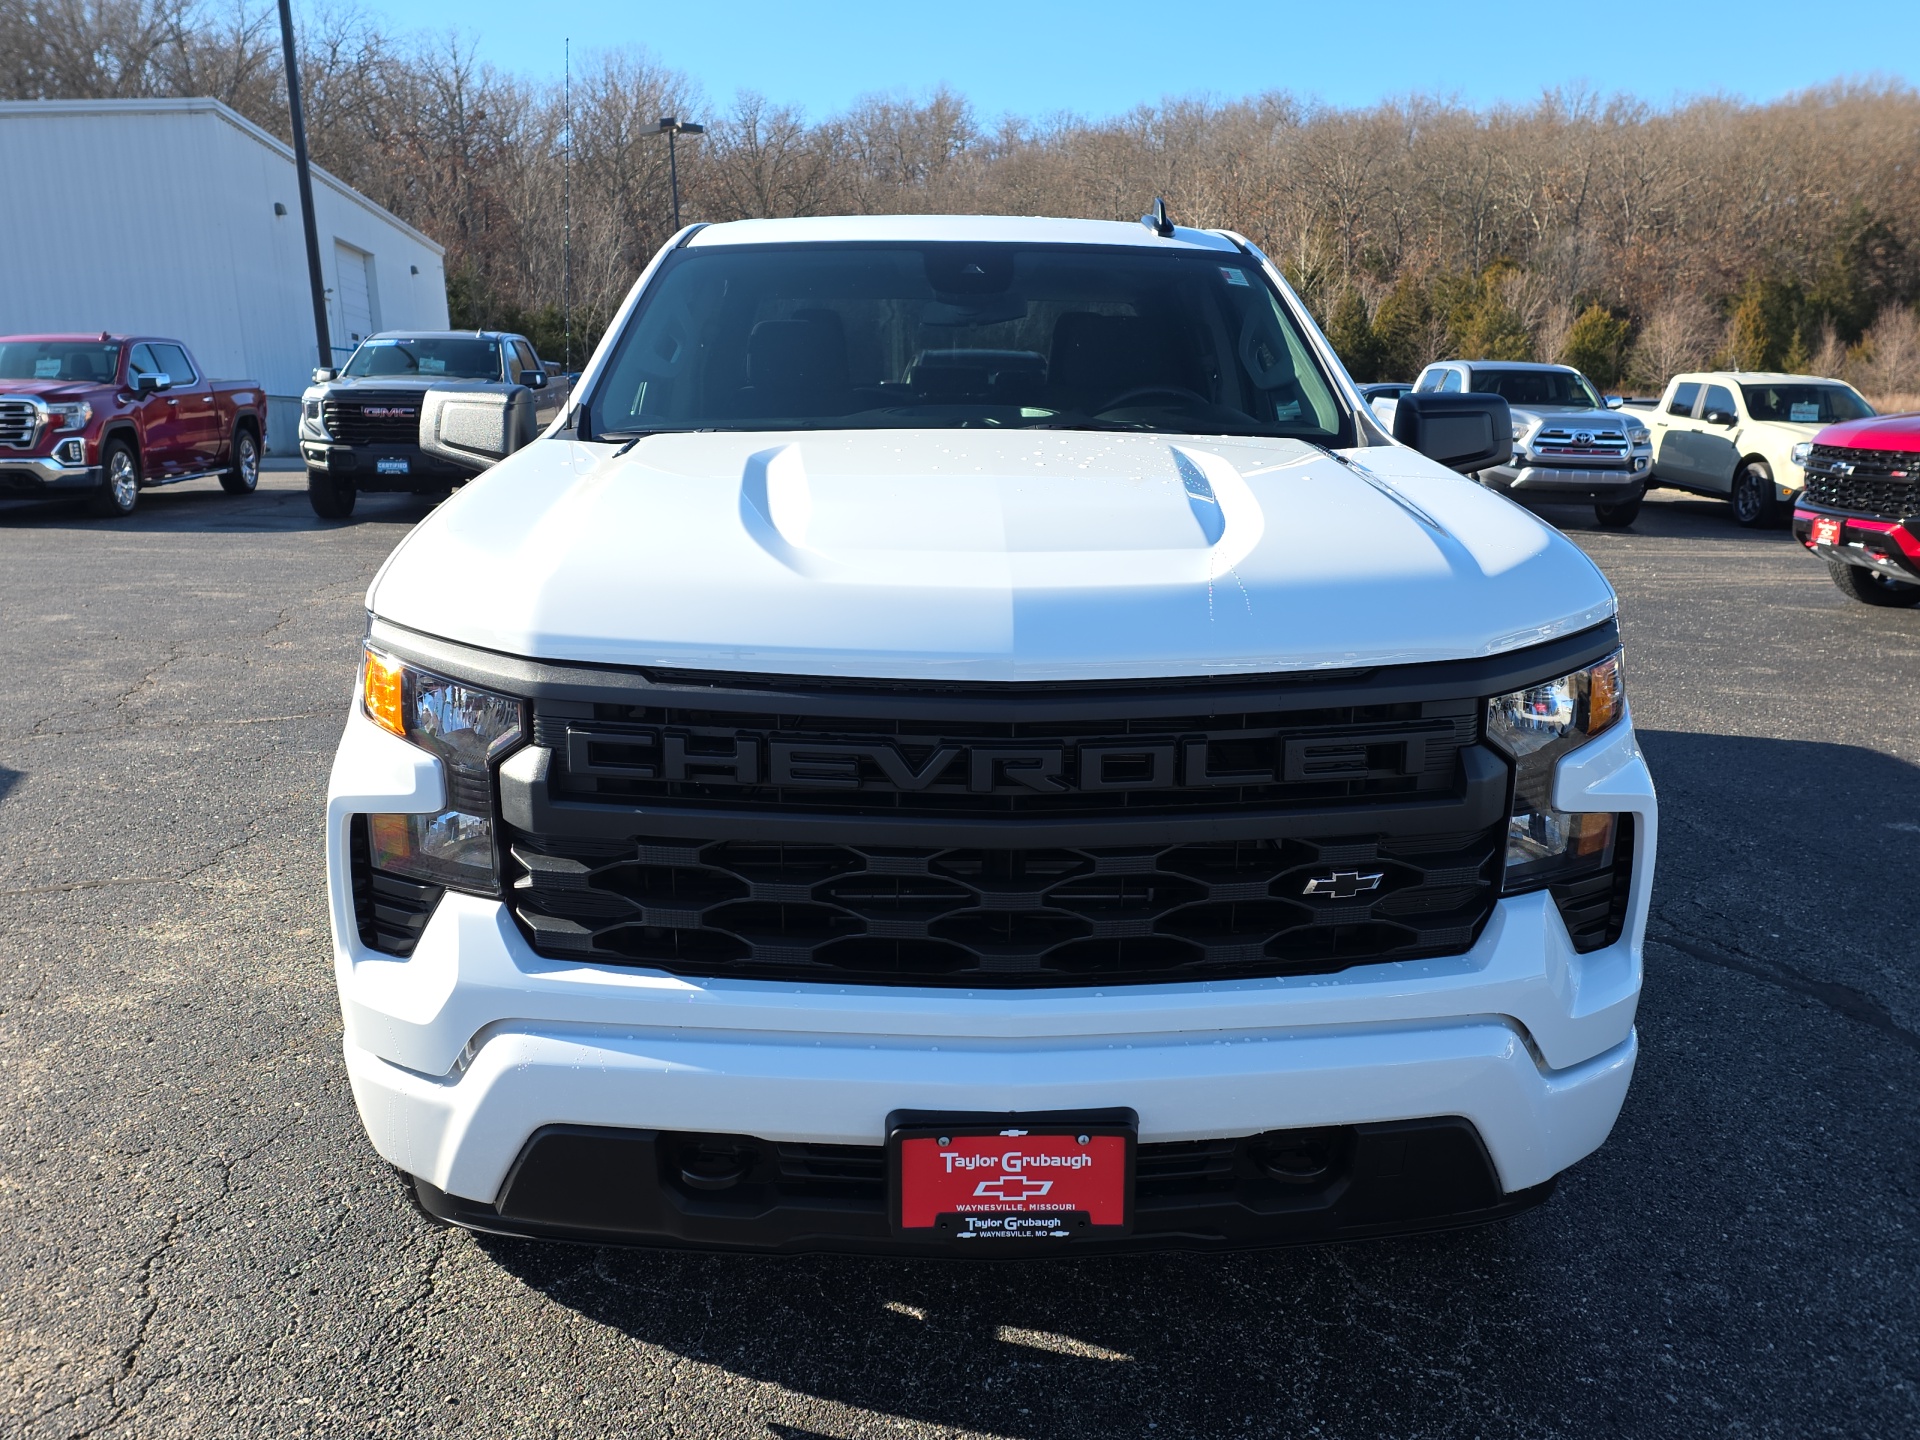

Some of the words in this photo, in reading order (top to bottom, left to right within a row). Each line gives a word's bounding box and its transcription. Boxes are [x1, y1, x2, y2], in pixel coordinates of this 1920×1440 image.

[364, 407, 415, 418] GMC
[566, 720, 1456, 792] CHEVROLET
[939, 1152, 999, 1173] Taylor
[1001, 1151, 1092, 1172] Grubaugh
[956, 1204, 1026, 1212] WAYNESVILLE,
[1029, 1203, 1076, 1211] MISSOURI
[965, 1217, 1002, 1231] Taylor
[1003, 1216, 1061, 1230] Grubaugh
